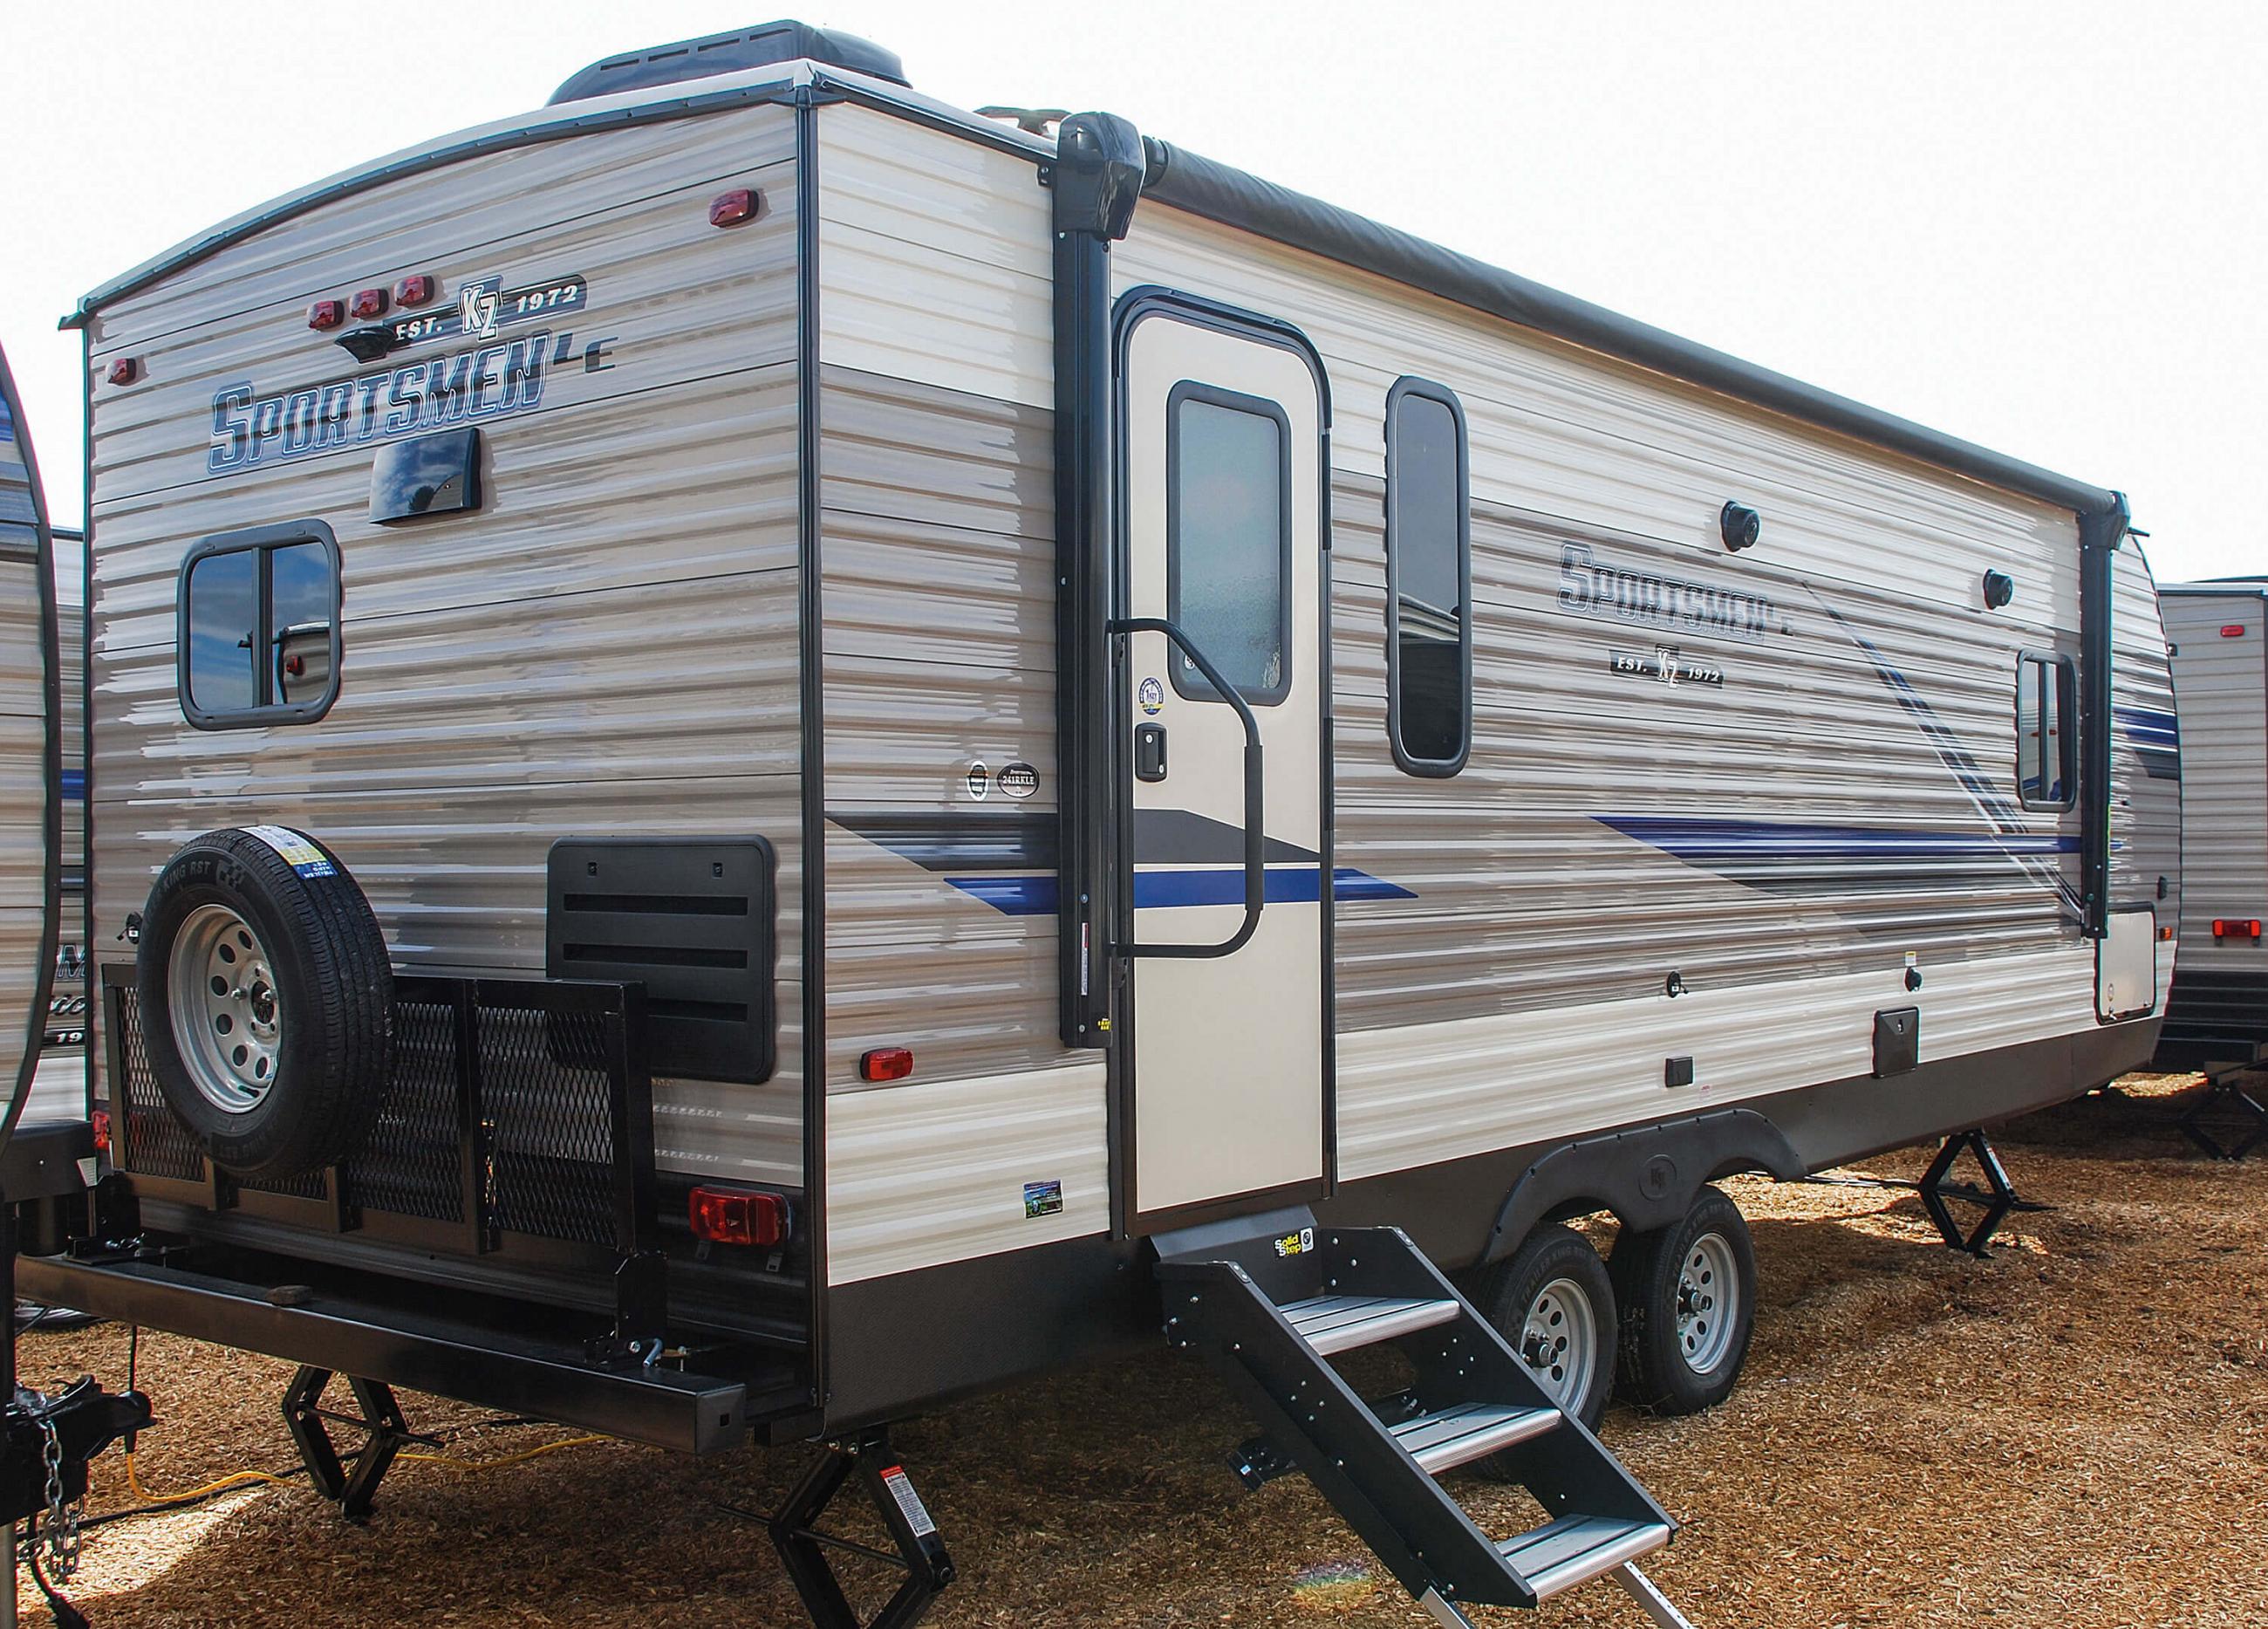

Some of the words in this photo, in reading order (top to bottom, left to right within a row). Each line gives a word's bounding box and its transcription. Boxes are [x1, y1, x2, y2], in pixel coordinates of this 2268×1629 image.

[395, 317, 443, 342] EST.
[461, 284, 500, 342] KZ
[517, 284, 578, 313] 1972
[208, 328, 552, 474] SPORTSMEN
[1557, 541, 1767, 642] SPORTSMEN
[1616, 656, 1648, 672] EST.
[1657, 647, 1678, 688] KZ
[1688, 667, 1720, 681] 1972
[163, 865, 186, 890] KING
[190, 859, 212, 875] RST
[1274, 1234, 1299, 1249] Solid
[1279, 1243, 1301, 1256] Step
